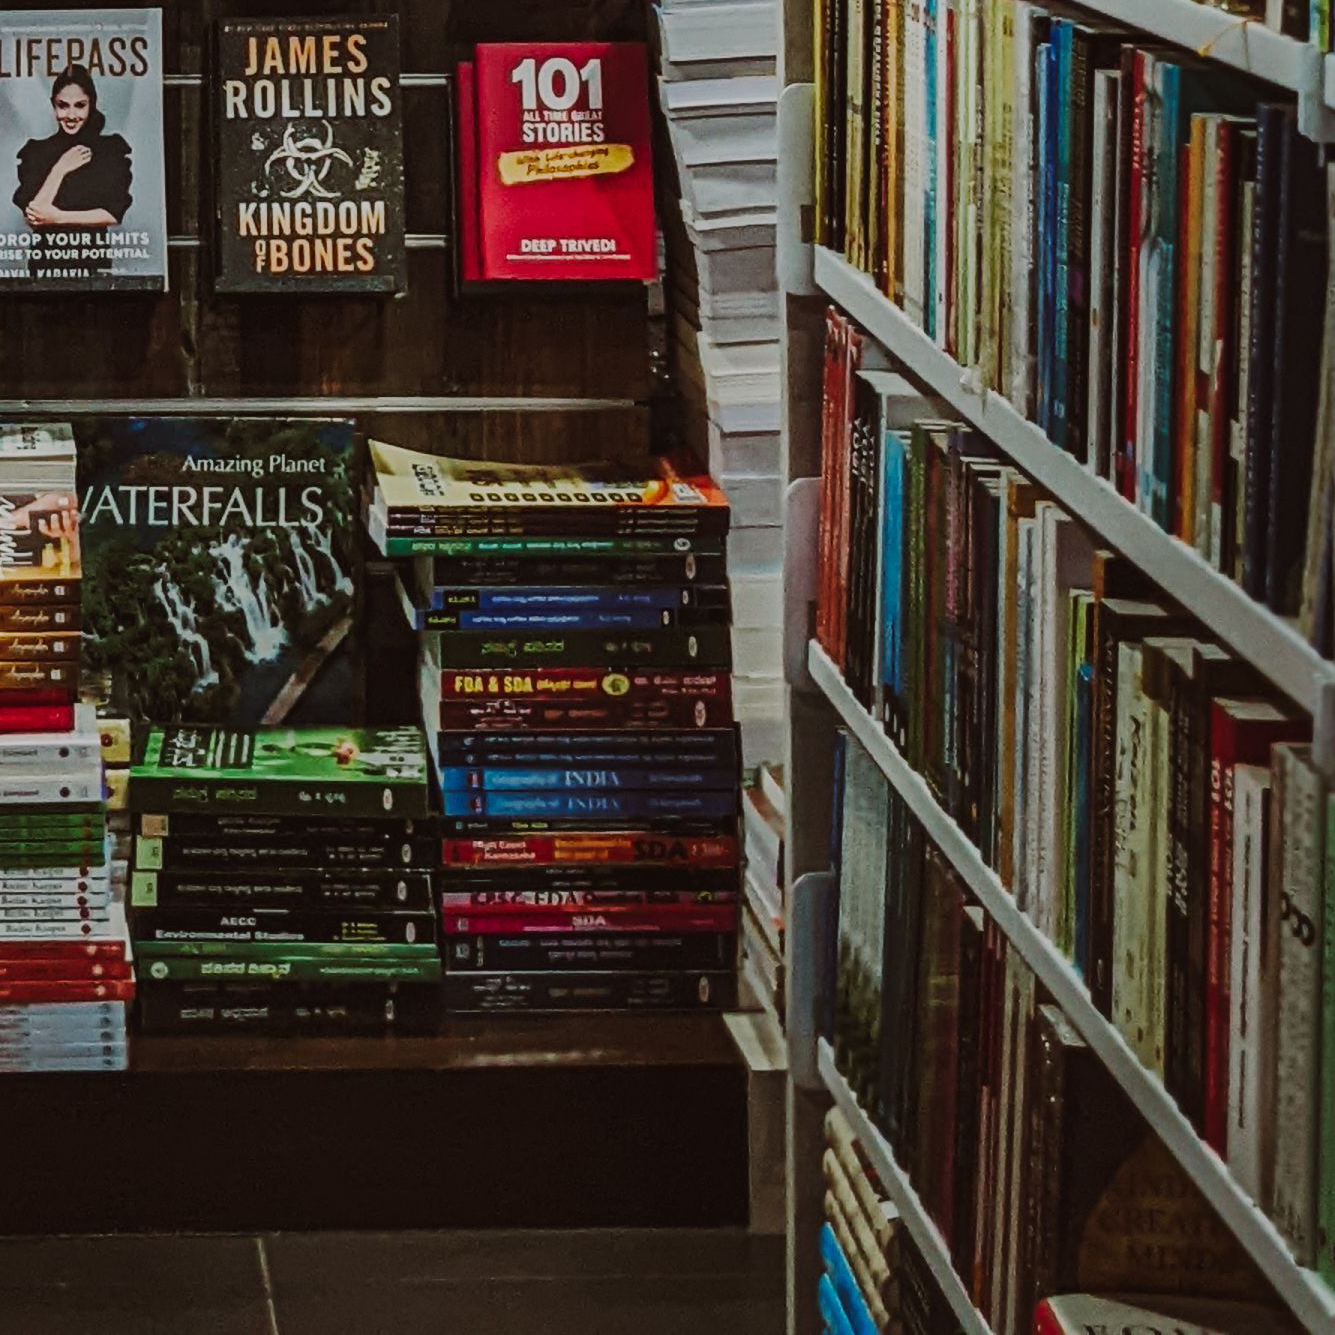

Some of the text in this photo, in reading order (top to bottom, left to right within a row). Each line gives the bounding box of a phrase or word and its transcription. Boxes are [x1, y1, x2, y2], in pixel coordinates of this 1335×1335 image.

[244, 34, 368, 77] JAMES
[512, 58, 603, 110] 101
[225, 77, 392, 119] ROLLINS
[523, 110, 542, 122] ALL
[523, 122, 604, 143] STORIES
[238, 200, 385, 236] KINGDOM
[46, 232, 92, 246] YOUR
[97, 231, 150, 245] LIMITS
[521, 238, 616, 252] DEEP TRIVEDI
[24, 249, 42, 260] TO
[45, 248, 78, 260] YOUR
[82, 248, 149, 259] POTENTIAL
[270, 238, 374, 273] BONES
[182, 454, 326, 477] Amazing Planet
